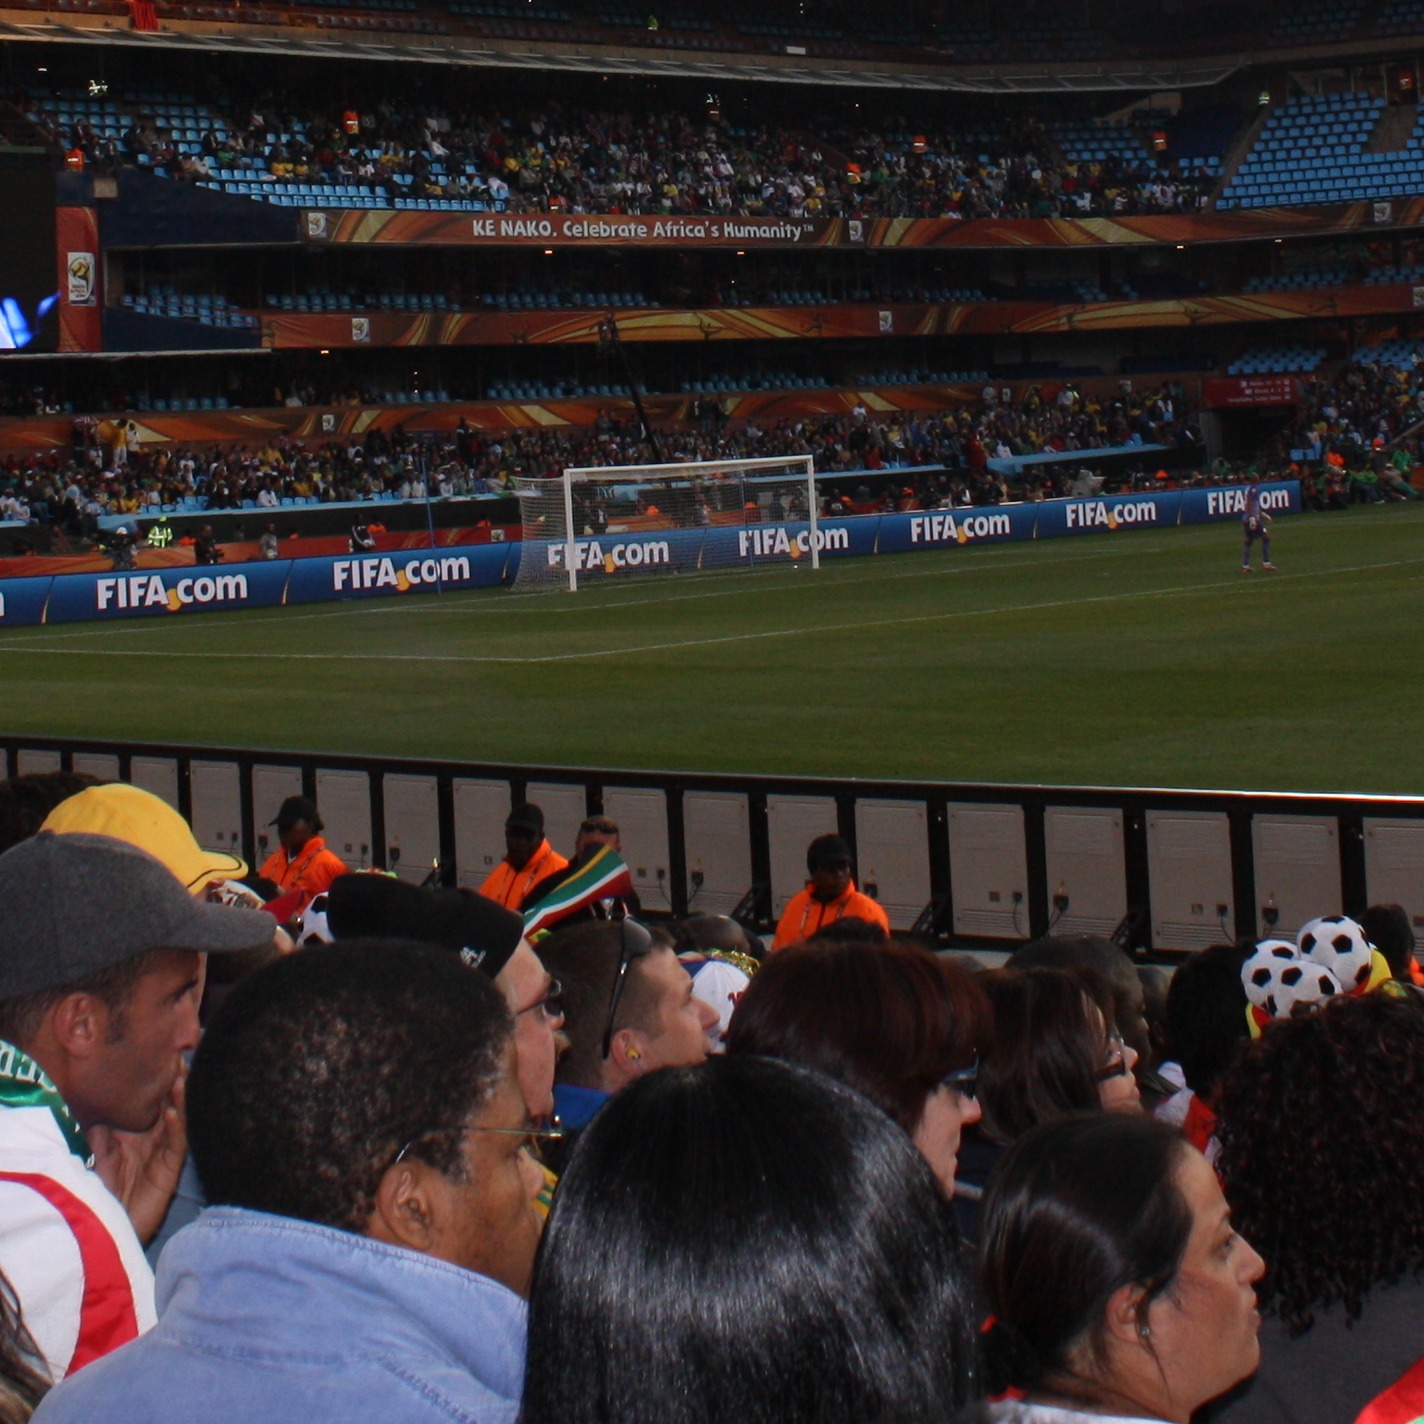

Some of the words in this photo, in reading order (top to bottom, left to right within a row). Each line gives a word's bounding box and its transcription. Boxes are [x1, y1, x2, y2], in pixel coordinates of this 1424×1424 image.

[473, 219, 495, 237] KE
[501, 220, 557, 238] NAKO.
[563, 220, 648, 238] Celebrate
[653, 221, 719, 238] Africa's
[910, 513, 1010, 544] FIFA.com
[1065, 501, 1156, 529] FIFA.com
[333, 555, 470, 591] FIFA.com
[96, 574, 248, 610] FIFA.com
